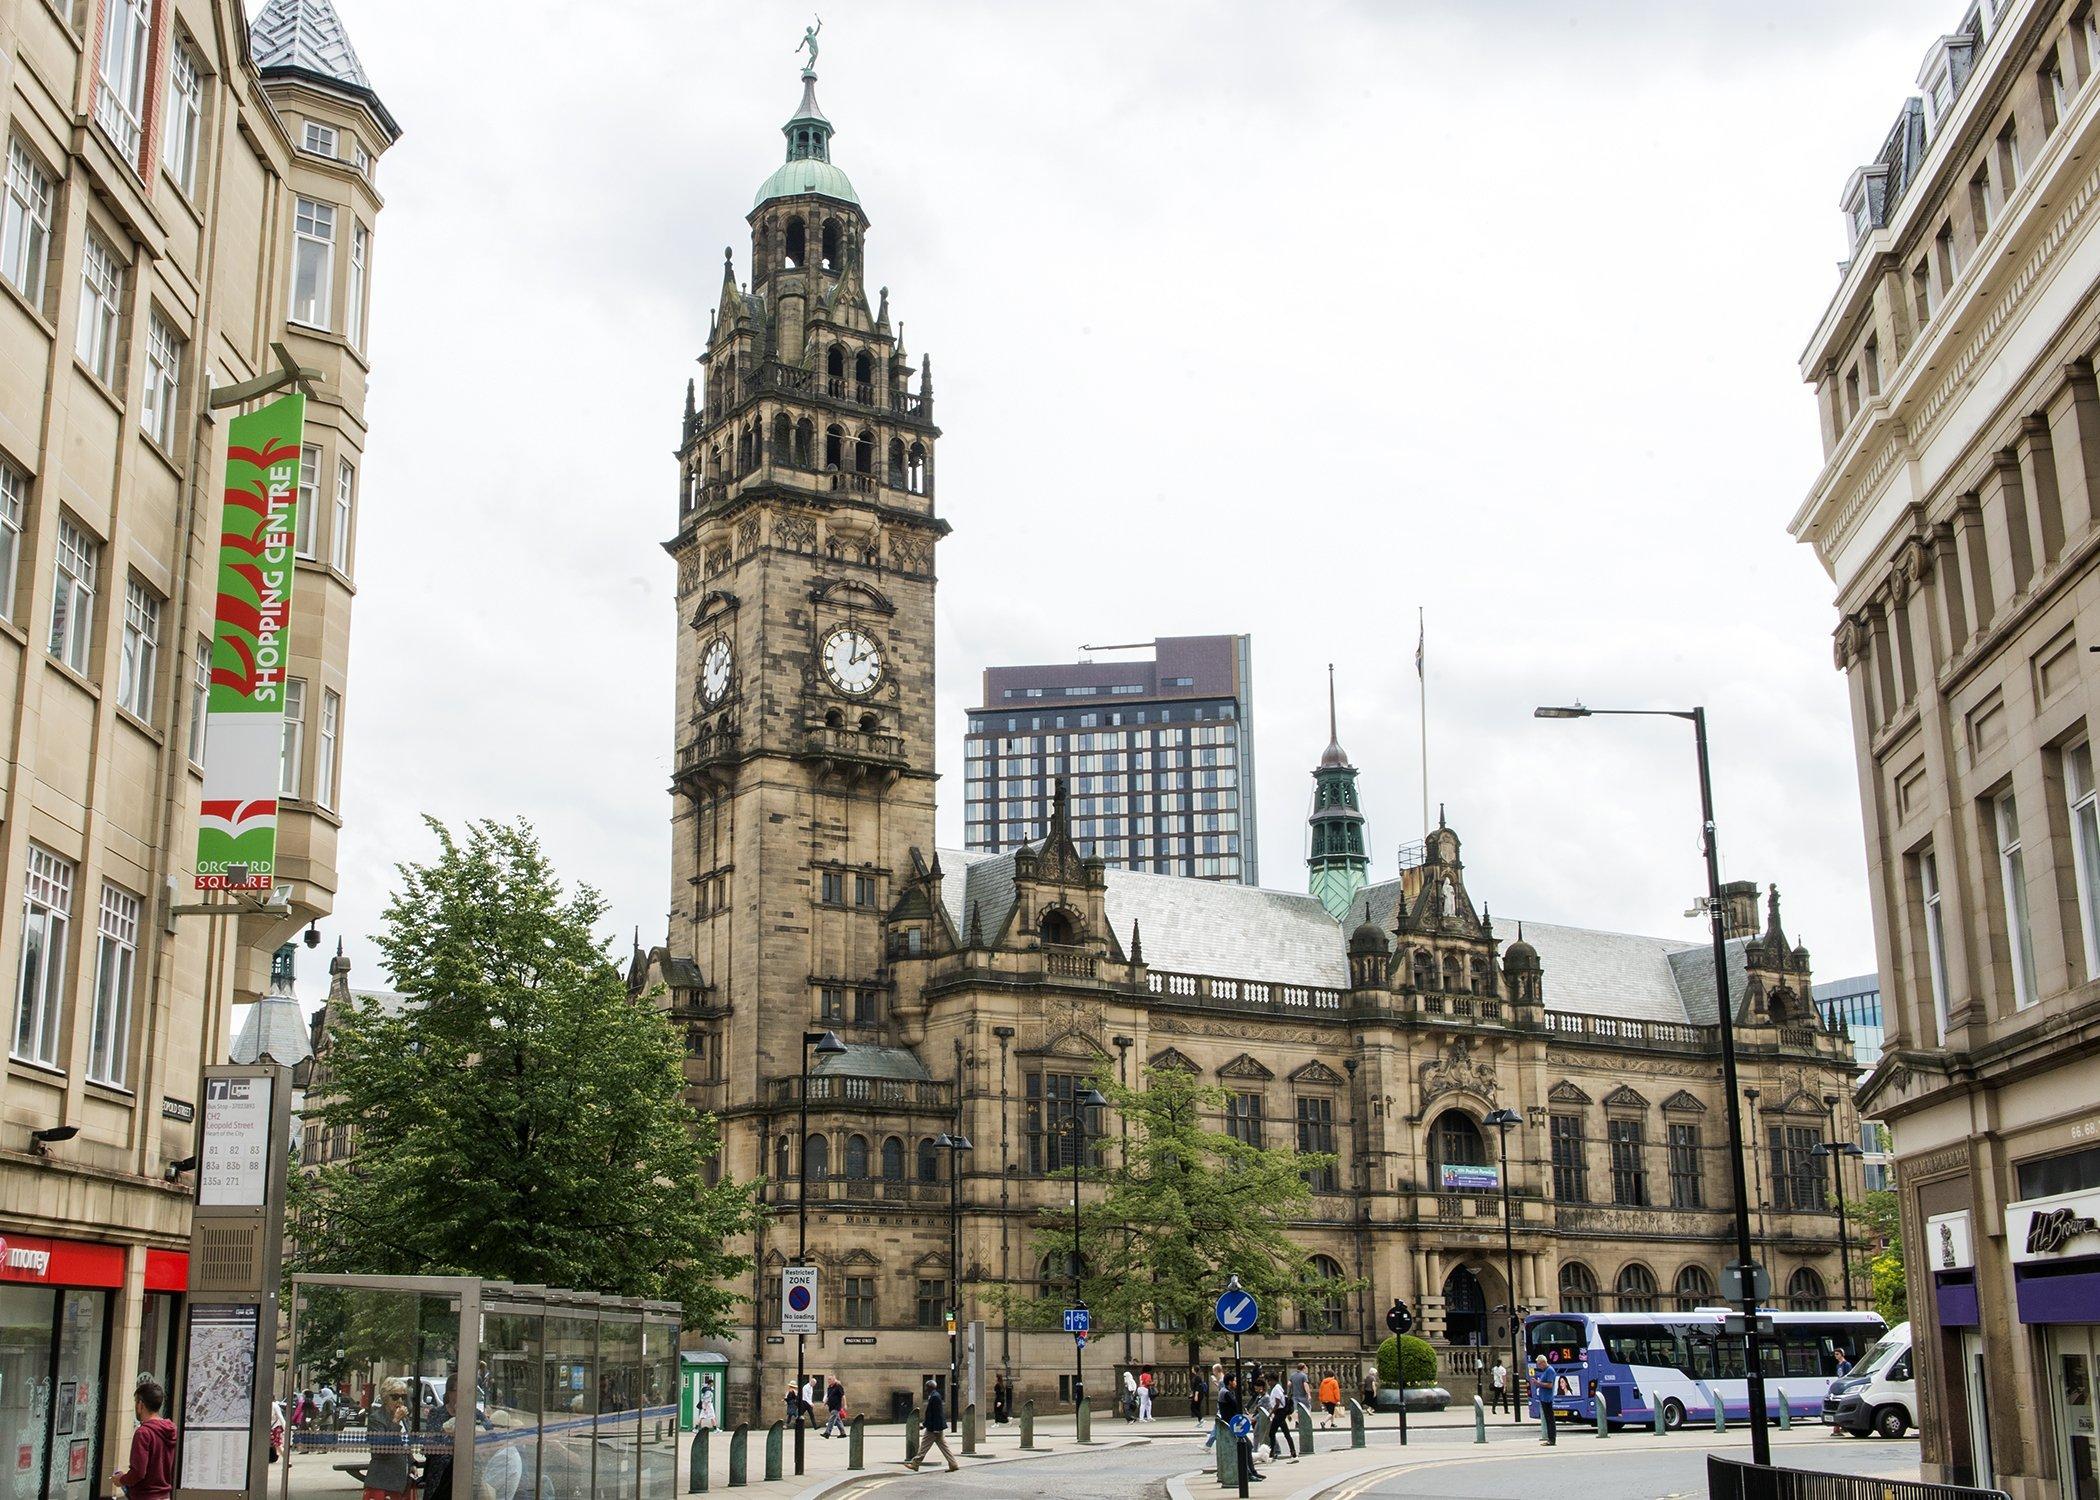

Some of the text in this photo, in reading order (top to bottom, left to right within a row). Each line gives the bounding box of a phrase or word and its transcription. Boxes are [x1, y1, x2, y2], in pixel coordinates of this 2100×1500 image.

[254, 466, 291, 702] SHOPPING CENTRE
[198, 861, 271, 873] ORCRD
[198, 876, 269, 888] SQURE
[217, 1103, 228, 1111] Stop
[207, 1112, 221, 1121] CH2
[206, 1121, 254, 1130] Leopold Street
[209, 1146, 260, 1155] 81 82 83
[206, 1161, 259, 1170] 83a 83b 88
[203, 1177, 239, 1186] 135a 271
[10, 1248, 51, 1276] money
[789, 1276, 810, 1284] ZONE
[794, 1313, 815, 1321] loading
[1562, 1348, 1572, 1359] 51
